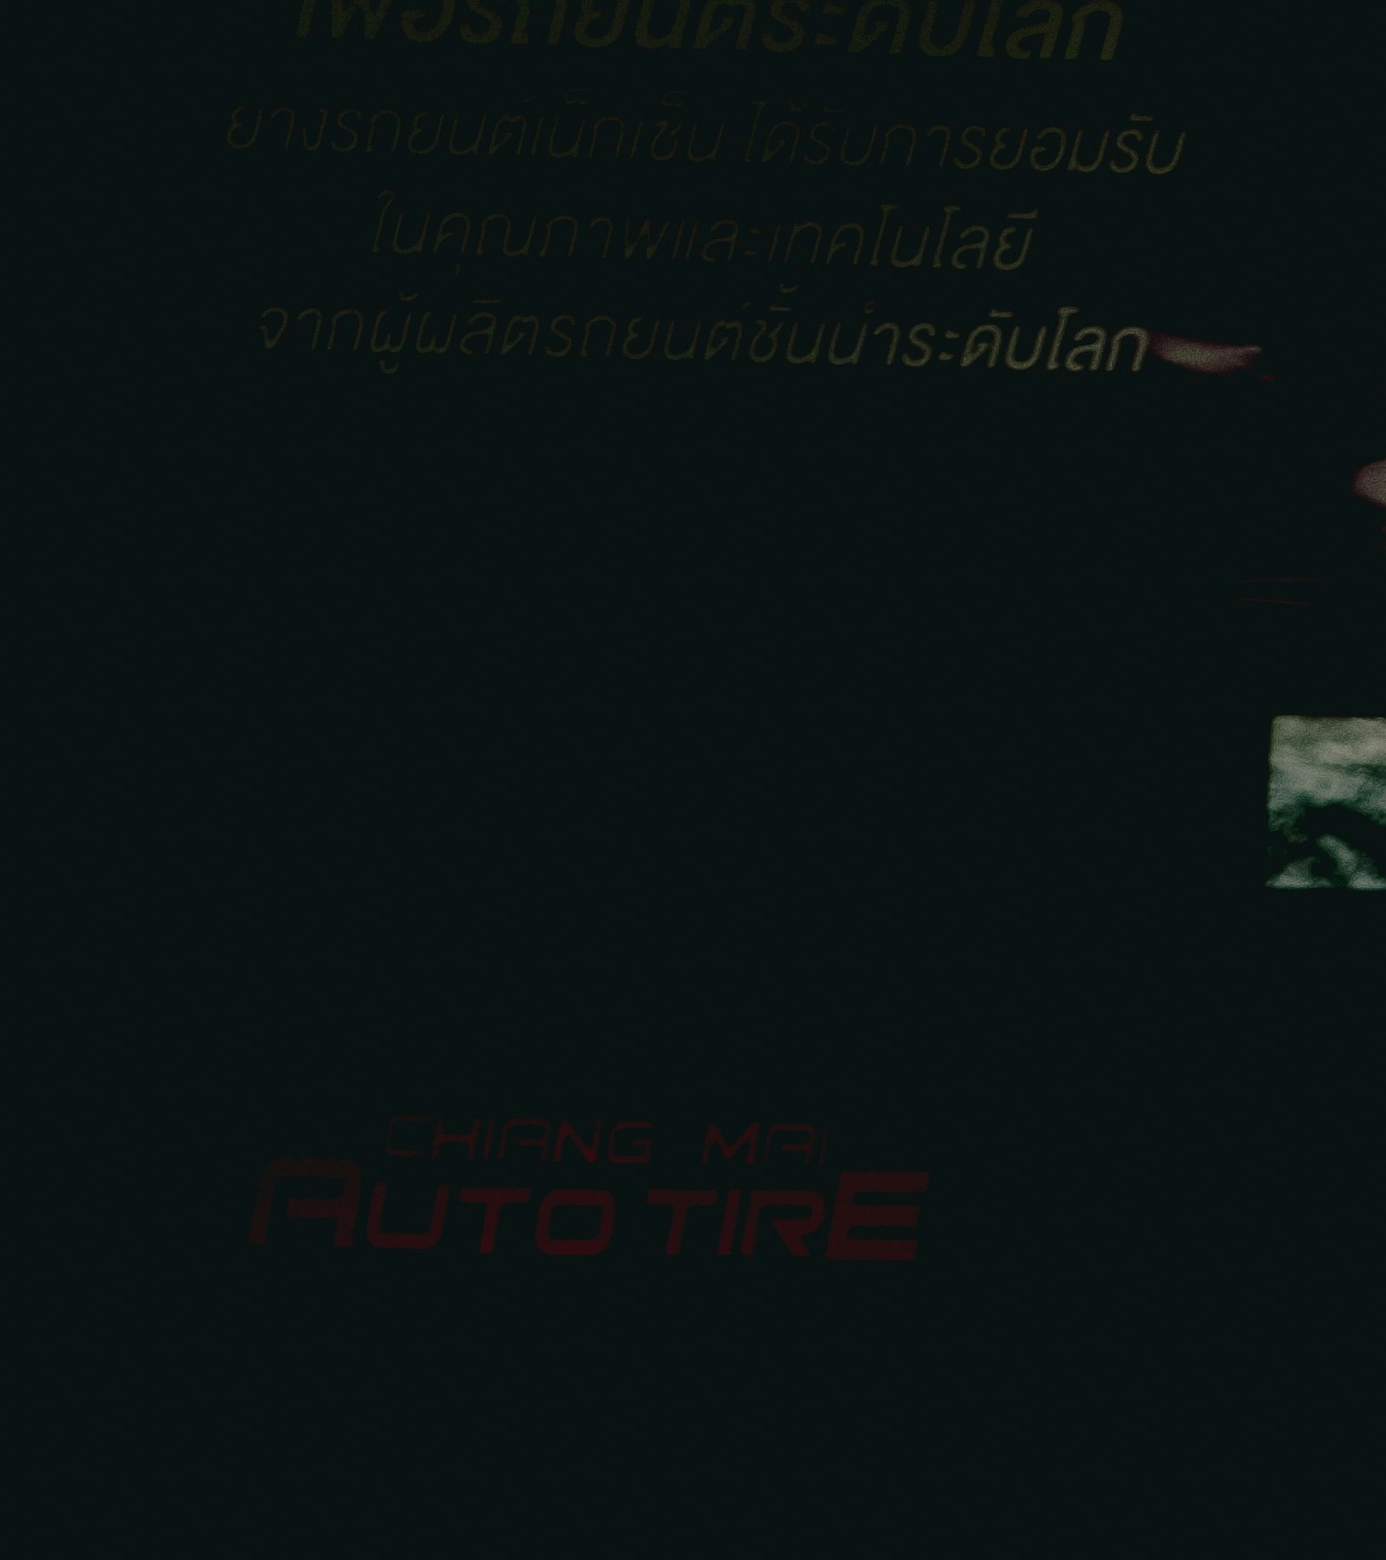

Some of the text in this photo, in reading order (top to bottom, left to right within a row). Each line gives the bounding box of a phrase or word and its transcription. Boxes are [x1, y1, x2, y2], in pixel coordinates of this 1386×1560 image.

[384, 1114, 654, 1164] CHIANG
[247, 1156, 932, 1262] AUTO TIRE
